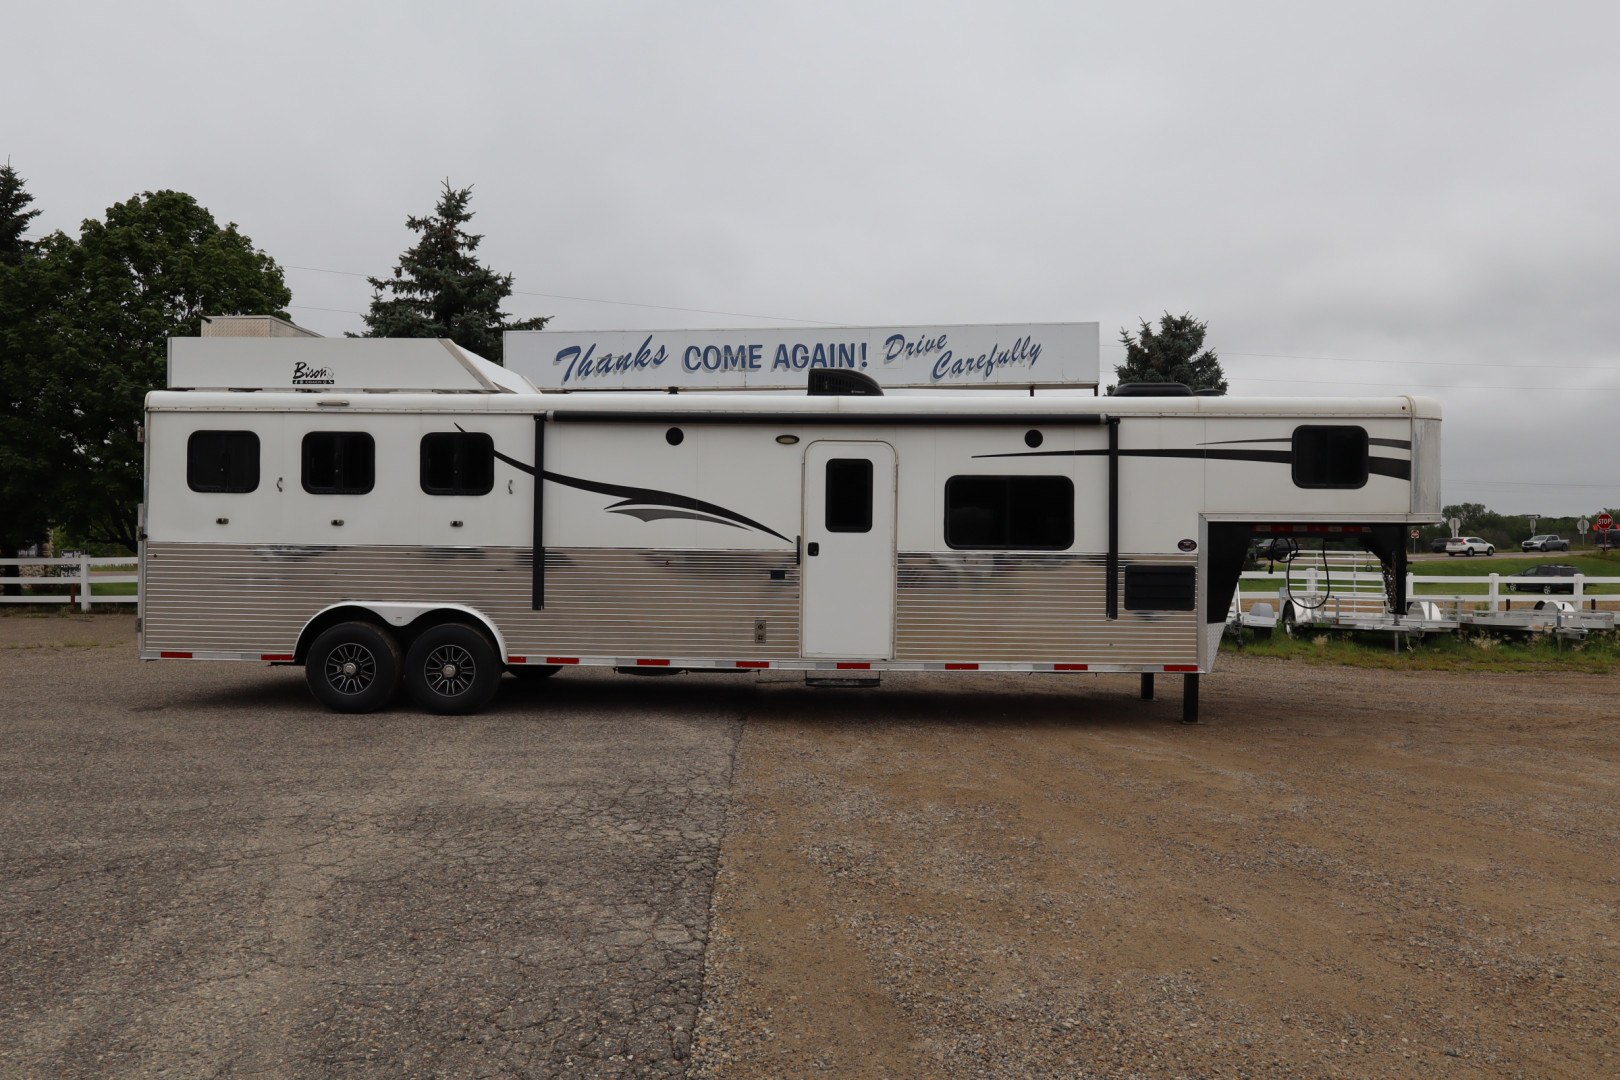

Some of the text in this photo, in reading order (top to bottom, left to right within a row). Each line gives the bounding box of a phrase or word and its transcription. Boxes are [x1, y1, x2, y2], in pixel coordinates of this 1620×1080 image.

[293, 361, 327, 379] Bison
[556, 335, 868, 382] Thanks COME AGAIN!
[885, 334, 1042, 379] Drive Carefully
